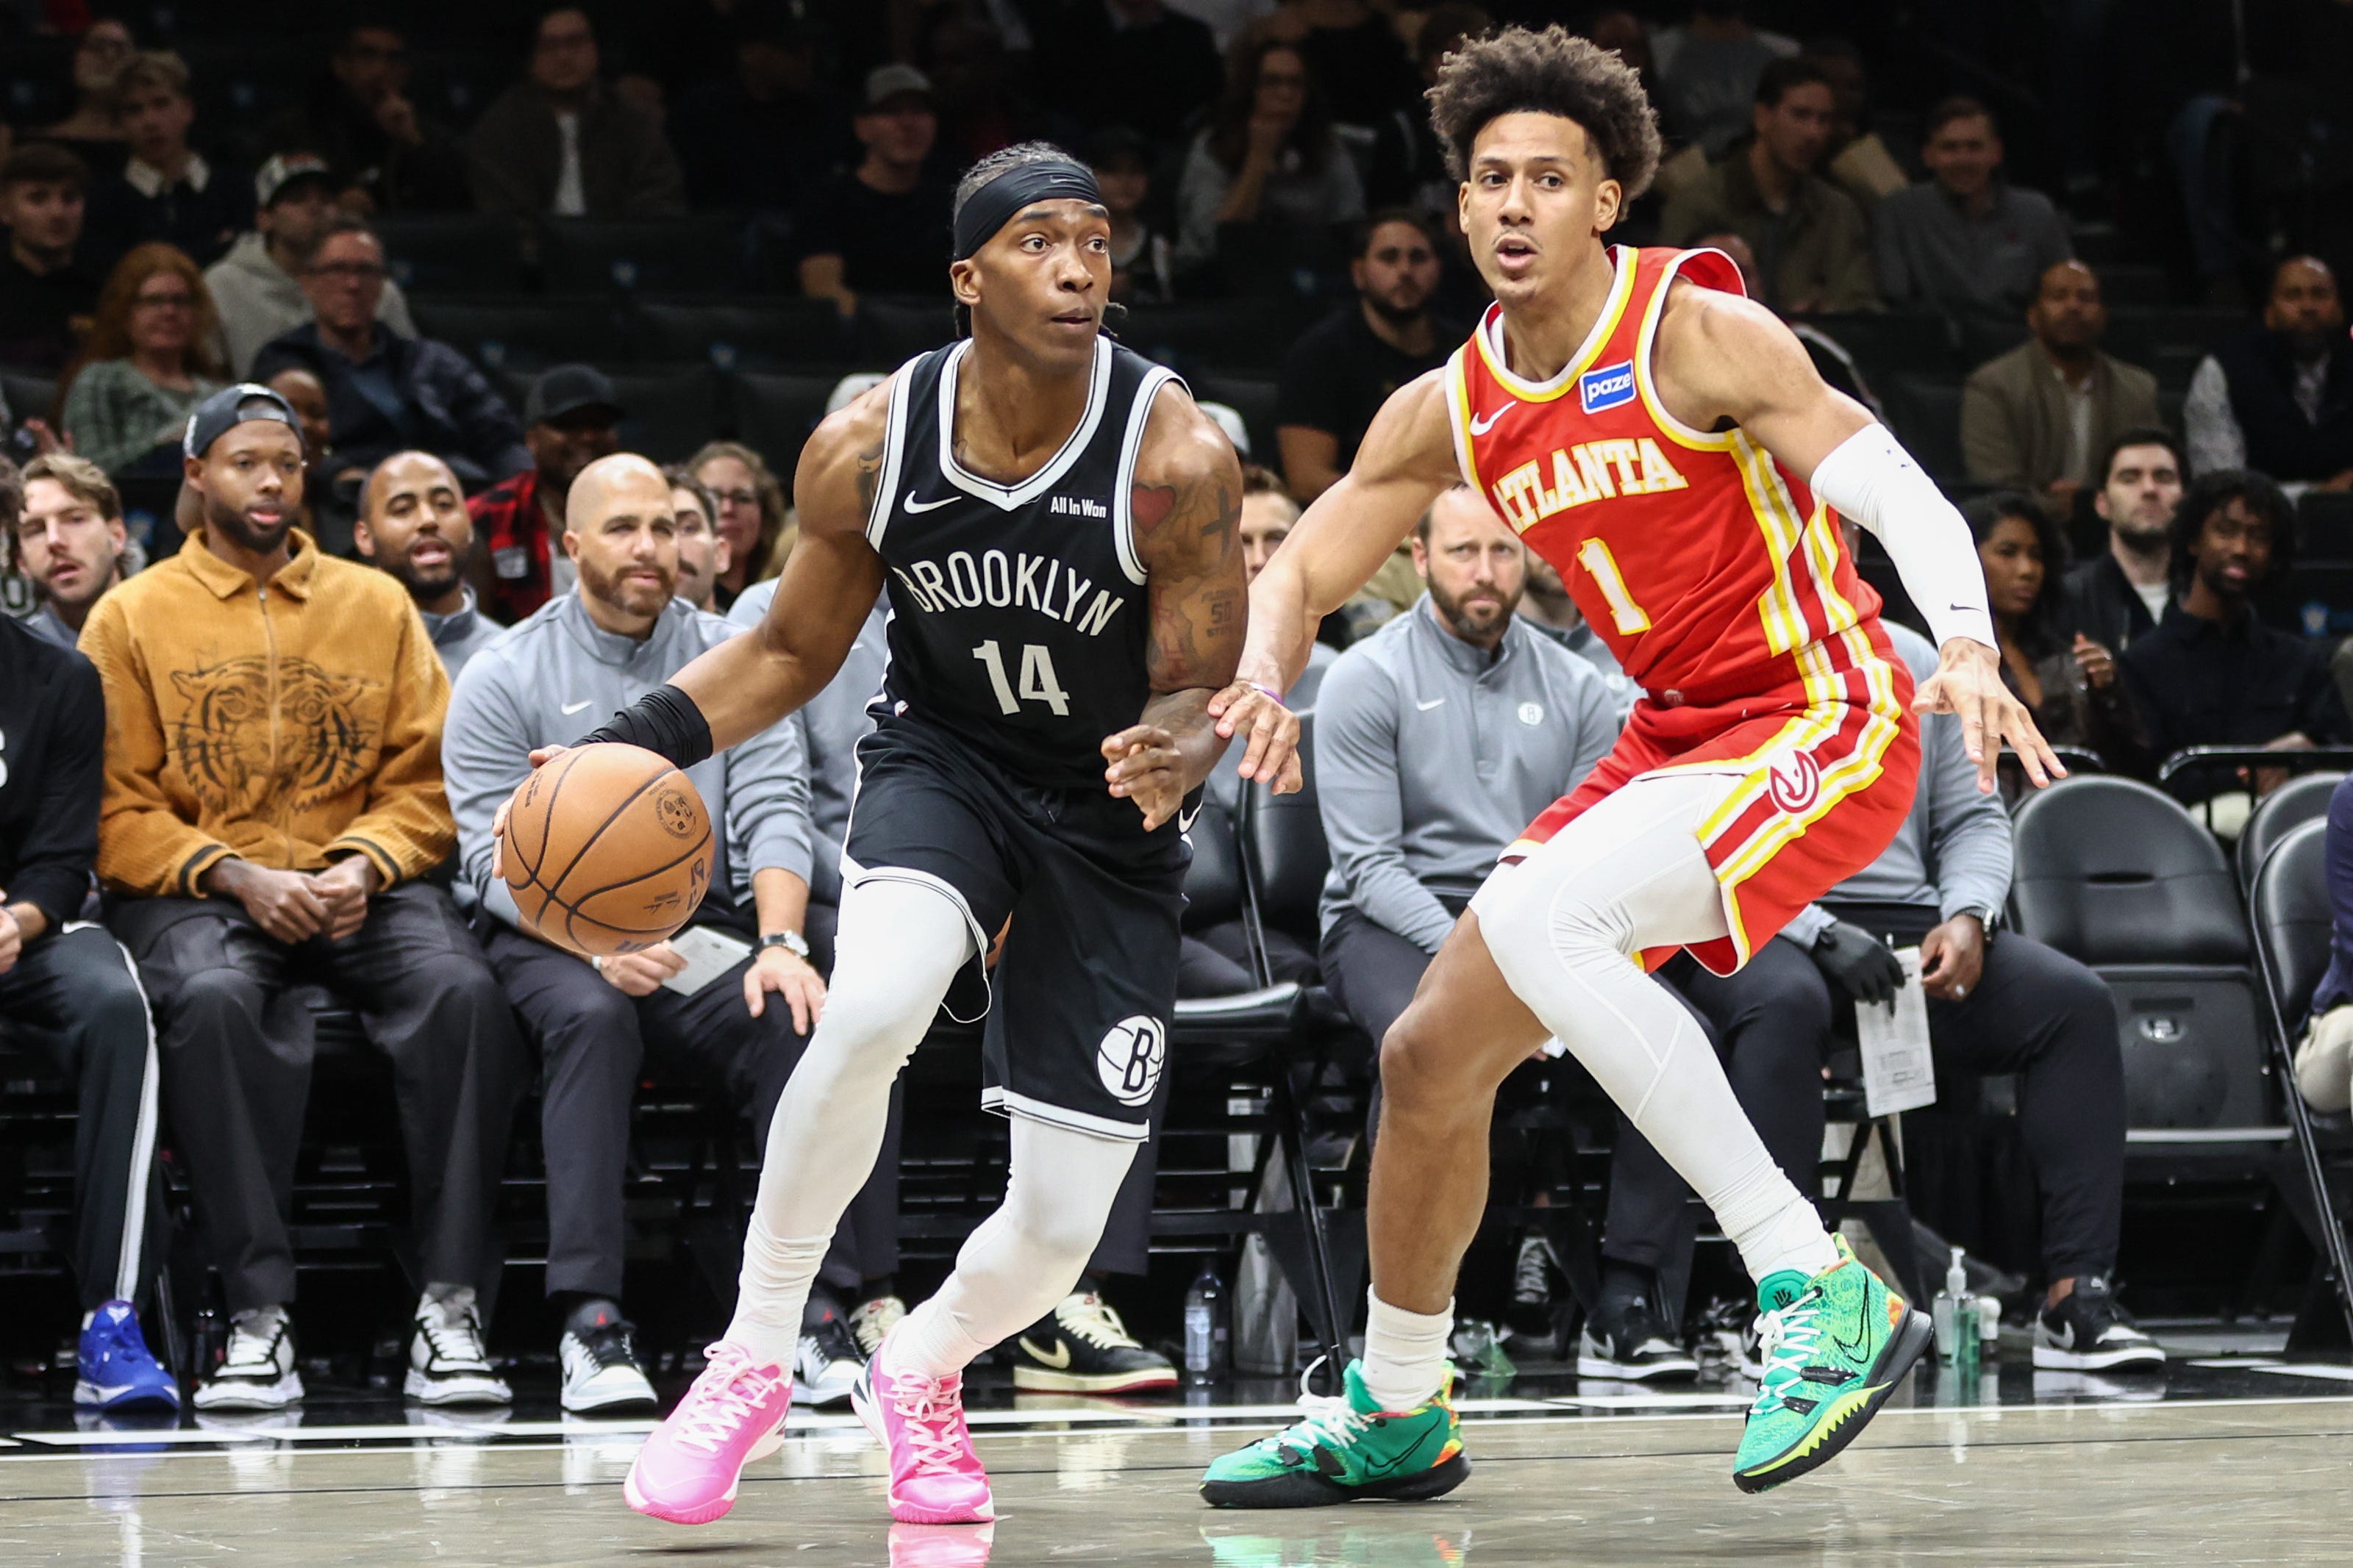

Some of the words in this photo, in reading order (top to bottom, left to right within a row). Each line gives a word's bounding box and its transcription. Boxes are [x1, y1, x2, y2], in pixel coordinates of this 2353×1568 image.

[1587, 372, 1632, 403] paze
[1050, 496, 1067, 514] All
[1068, 498, 1080, 515] In
[1081, 498, 1107, 518] Won
[890, 549, 1124, 636] BROOKLYN
[1577, 537, 1652, 636] 1
[971, 639, 1071, 716] 14
[1121, 1026, 1154, 1093] B
